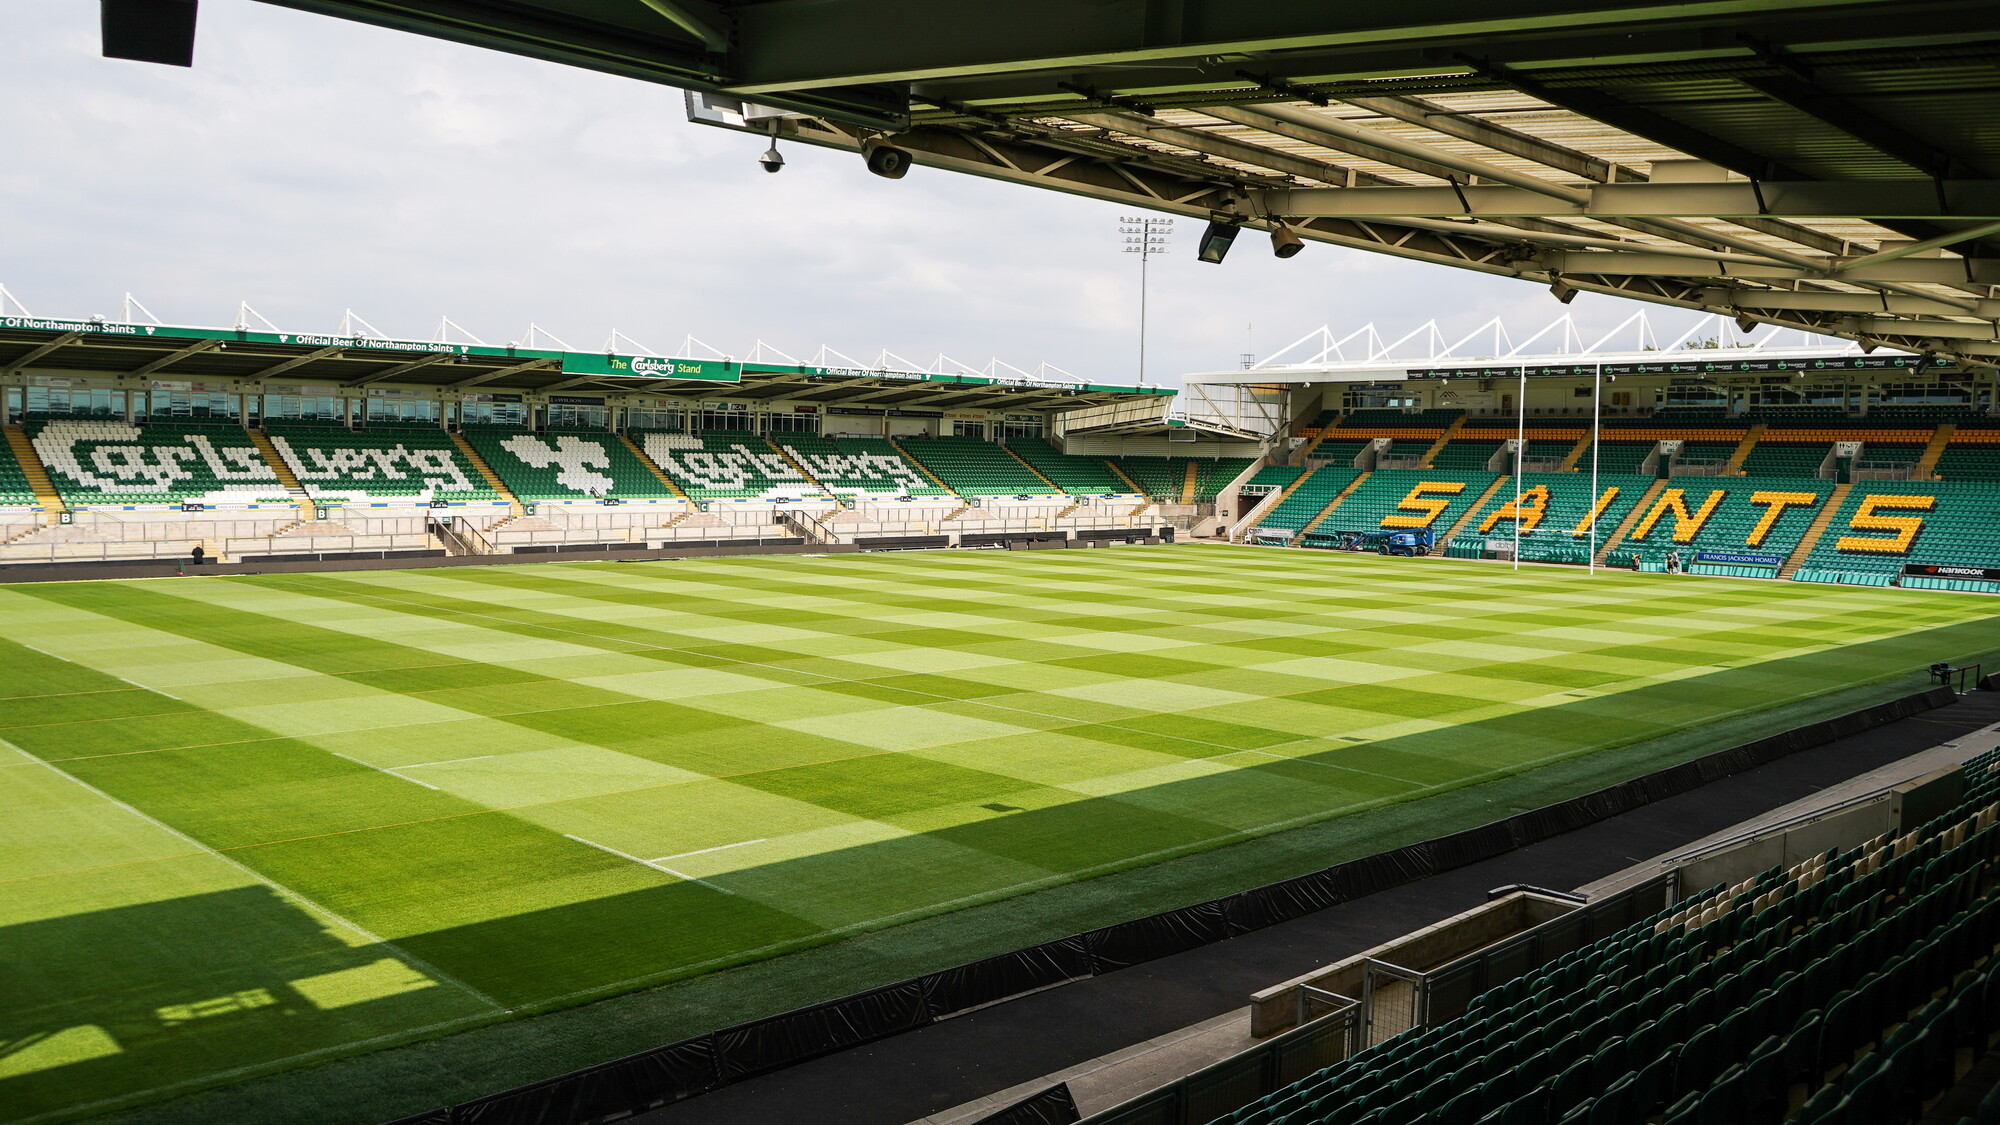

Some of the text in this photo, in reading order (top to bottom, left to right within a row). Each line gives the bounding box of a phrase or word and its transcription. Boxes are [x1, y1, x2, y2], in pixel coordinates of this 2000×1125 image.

[6, 317, 21, 328] Of
[23, 319, 101, 333] Northampton
[102, 323, 136, 334] Saints
[296, 335, 454, 353] Official Beer Of Northampton Saints
[611, 356, 701, 376] The Carlsberg Stand
[826, 367, 847, 376] Official
[861, 369, 869, 377] Of
[869, 370, 906, 379] Northampton
[906, 372, 921, 380] Saints
[997, 378, 1014, 386] Official
[1033, 381, 1062, 390] Northampton
[701, 503, 707, 512] C
[848, 500, 854, 509] D
[318, 509, 326, 519] B
[526, 506, 534, 515] C
[61, 513, 71, 523] B
[1380, 482, 1936, 553] SAINTS
[1703, 553, 1727, 561] FRANCIS
[1728, 555, 1754, 563] JACKSON
